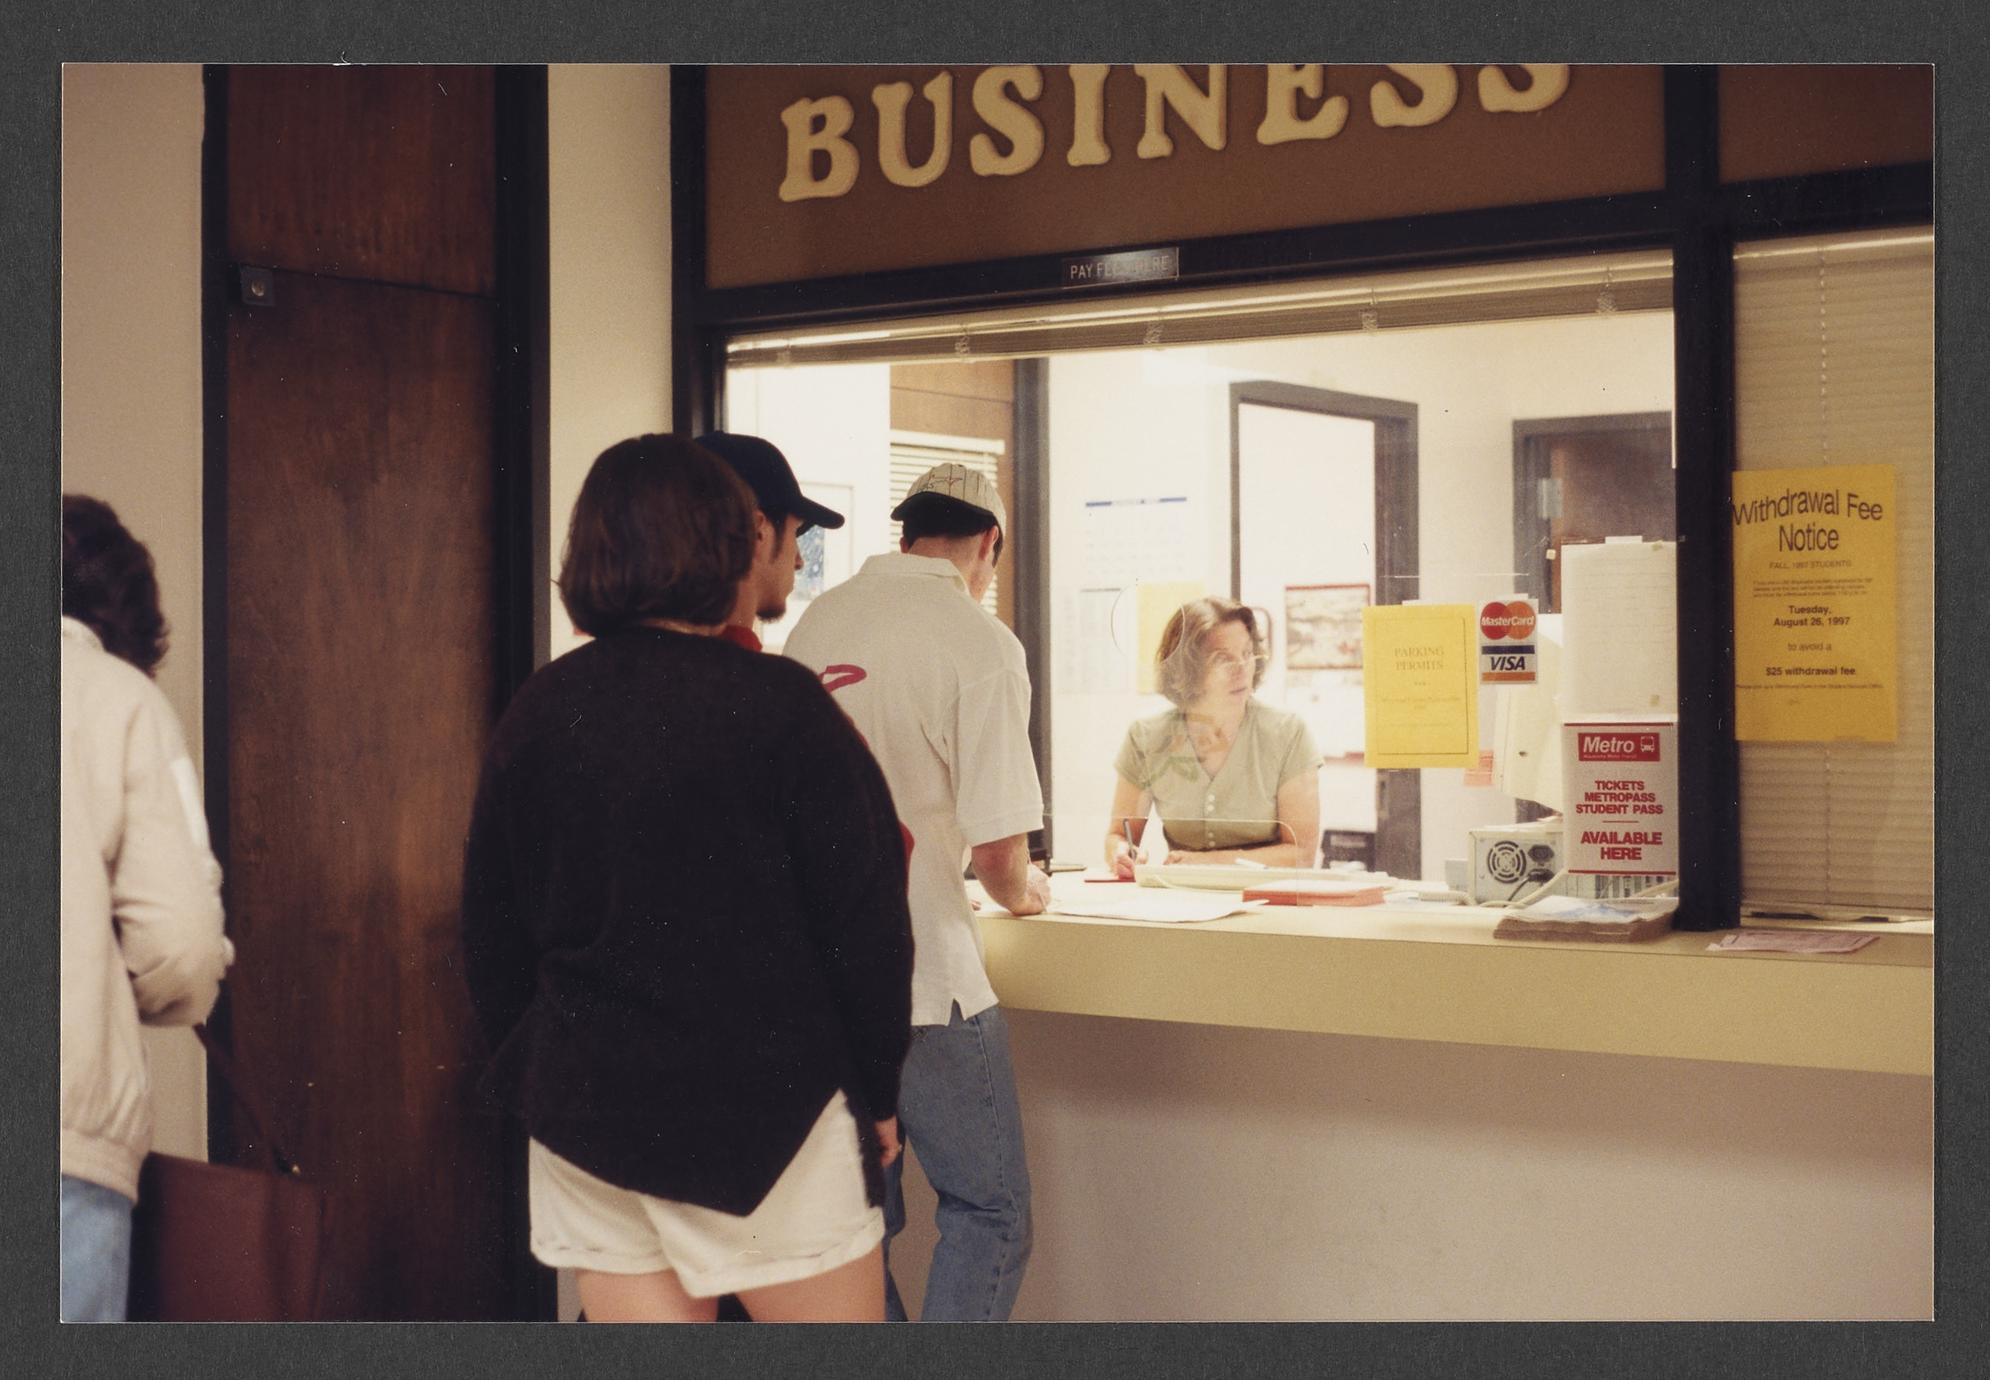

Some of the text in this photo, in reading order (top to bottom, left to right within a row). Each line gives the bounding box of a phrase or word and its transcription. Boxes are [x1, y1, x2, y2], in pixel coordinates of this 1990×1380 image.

[1070, 264, 1093, 280] PAY
[1096, 259, 1128, 277] FEE
[1732, 488, 1883, 526] Withdrawal Fee
[1779, 522, 1839, 552] Notice
[1481, 614, 1534, 627] MasterCard
[1774, 617, 1808, 628] August
[1828, 616, 1850, 626] 1997
[1394, 646, 1445, 658] PARKING
[1395, 660, 1444, 671] PERMITS
[1490, 656, 1526, 671] VISA
[1785, 666, 1838, 676] withdrawal
[1583, 736, 1635, 753] Metro
[1595, 780, 1645, 791] TICKETS
[1584, 792, 1656, 803] METROPASS
[1576, 804, 1664, 815] STUDENT PASS
[1581, 831, 1663, 846] AVAILABLE
[1600, 847, 1643, 861] HERE
